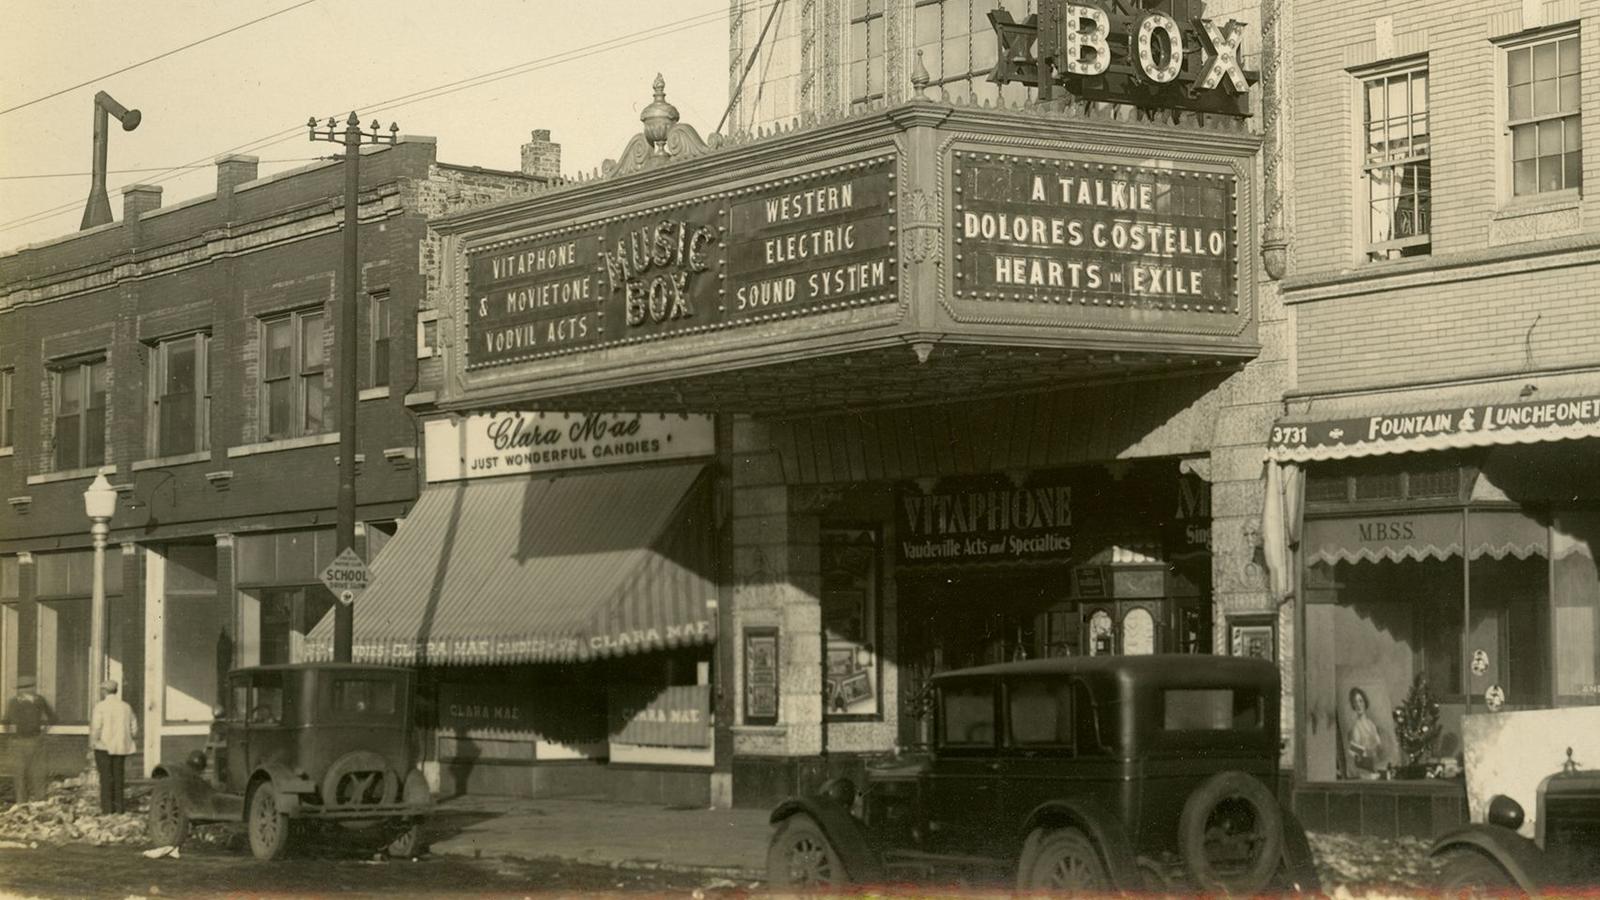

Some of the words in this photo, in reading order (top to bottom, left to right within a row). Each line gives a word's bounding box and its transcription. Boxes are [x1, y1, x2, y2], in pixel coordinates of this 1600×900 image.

[1066, 2, 1249, 92] BOX
[766, 184, 852, 223] WESTERN
[1031, 176, 1046, 201] A
[1058, 177, 1153, 210] TALKIE
[766, 225, 855, 264] ELECTRIC
[964, 213, 1084, 247] DOLORES
[1093, 222, 1224, 255] COSTELLO
[492, 241, 577, 279] VITAPHONE
[605, 220, 715, 292] MUSIC
[995, 256, 1102, 289] HEARTS
[1109, 272, 1122, 283] IN
[1132, 265, 1203, 294] EXILE
[479, 297, 489, 317] &
[507, 277, 591, 313] MOVIETONE
[625, 271, 691, 326] BOX
[736, 278, 797, 310] SOUND
[808, 259, 884, 297] SYSTEM
[485, 325, 537, 352] VODVIL
[547, 317, 588, 343] ACTS
[487, 417, 561, 450] Clara
[568, 414, 642, 441] Mae
[1272, 425, 1308, 443] 3731
[1368, 411, 1453, 440] FOUNTAIN
[1458, 408, 1476, 431] &
[471, 457, 499, 470] JUST
[506, 447, 587, 467] WONDERFUL
[592, 439, 660, 458] CANDIES
[903, 486, 1072, 535] VITAPHONE
[903, 537, 961, 559] Vaudeville
[962, 537, 988, 555] Acts
[1009, 533, 1072, 556] Specialties
[326, 569, 369, 581] SCHOOL
[590, 628, 660, 649] CLARA
[666, 620, 709, 639] MAE
[449, 704, 489, 719] CLARA
[494, 705, 522, 720] MAE
[670, 708, 700, 723] MAE
